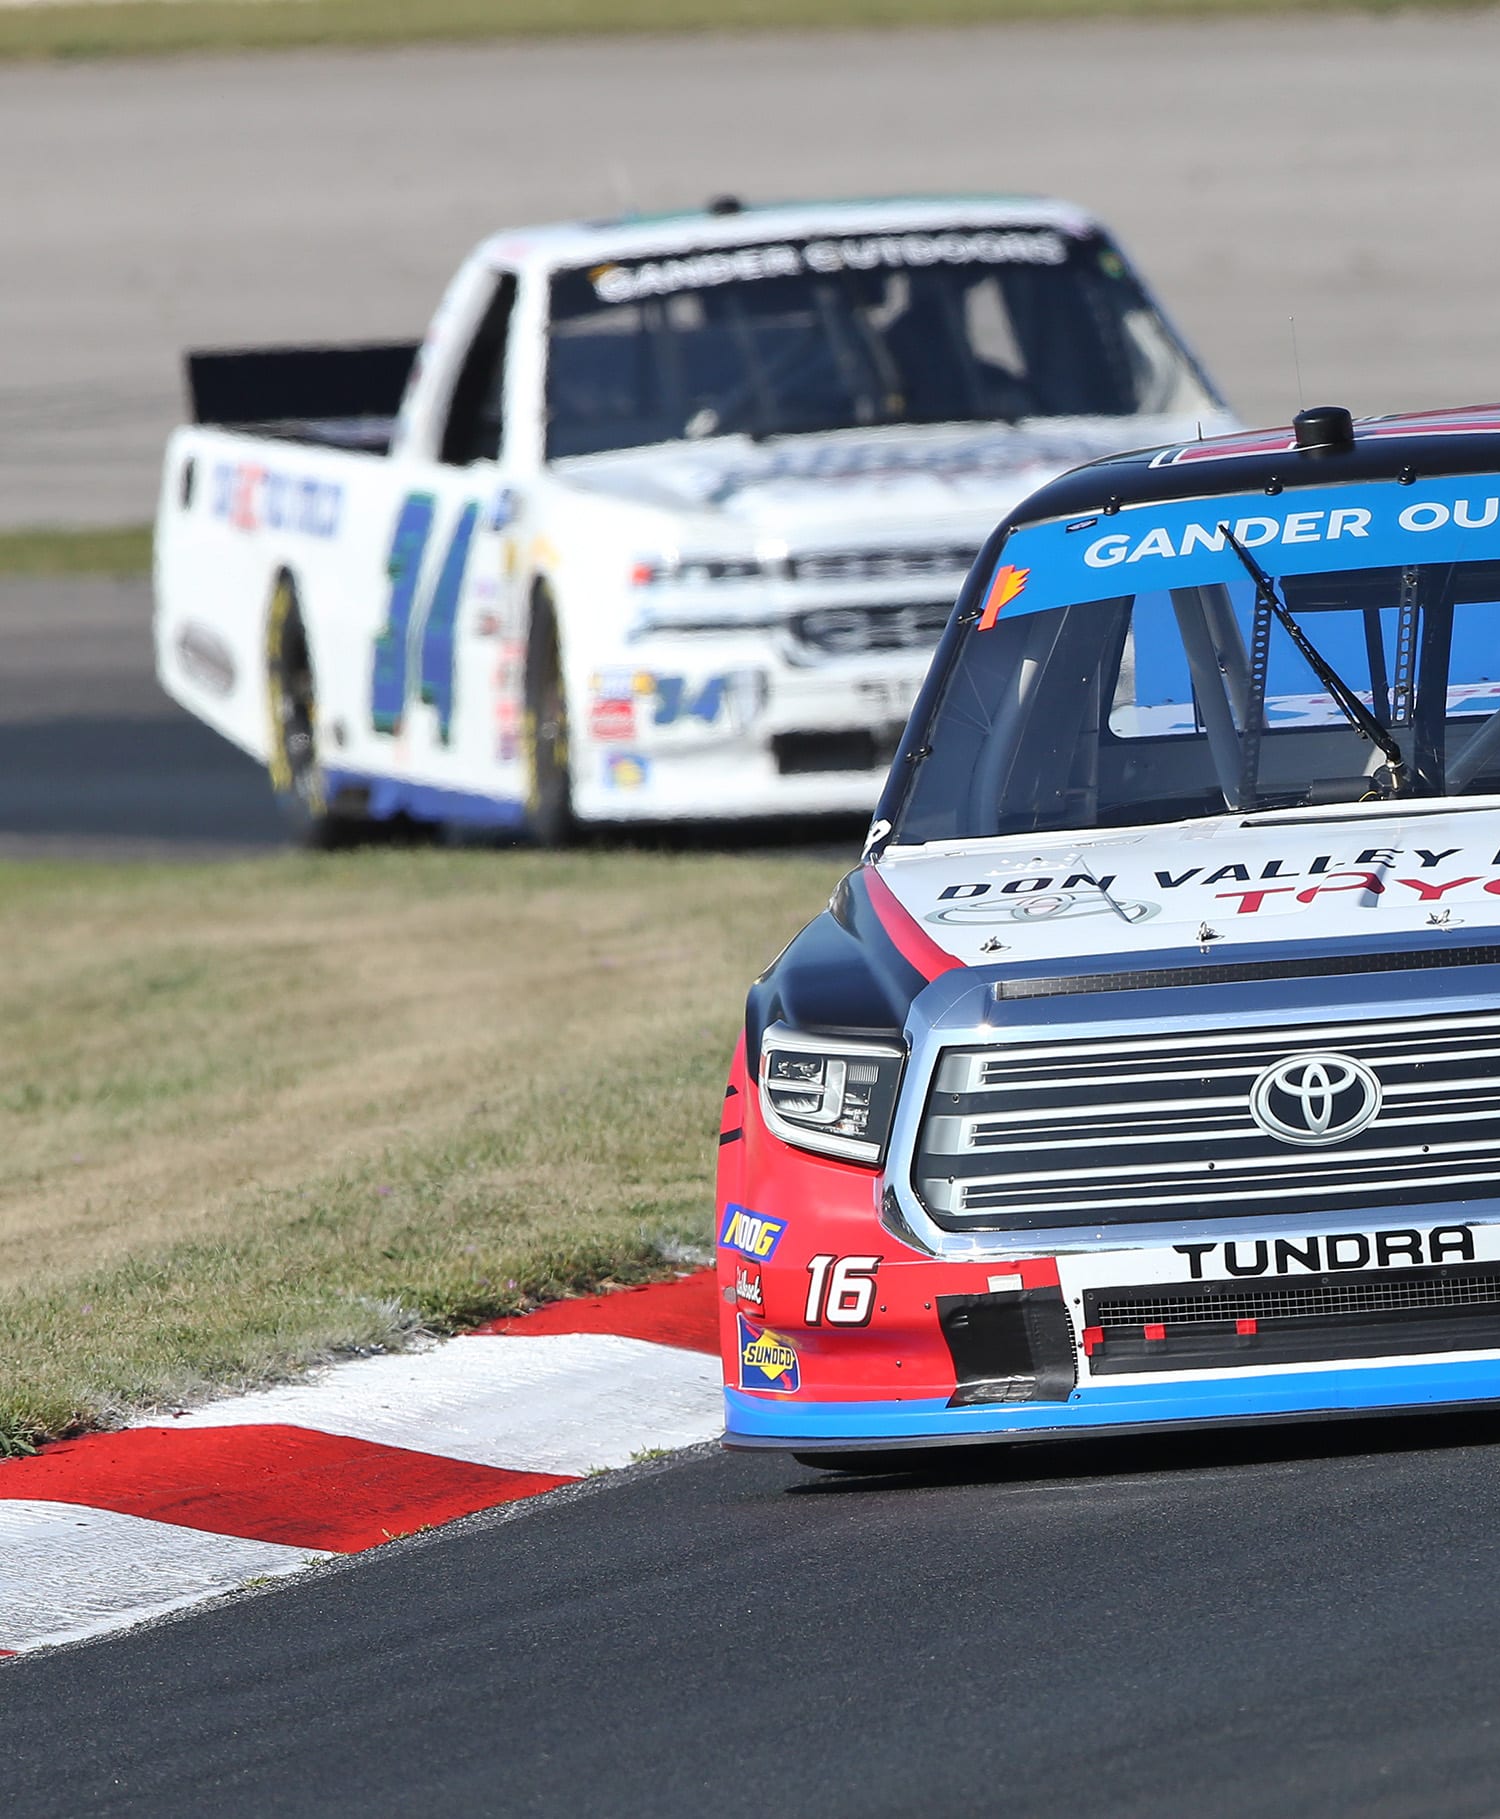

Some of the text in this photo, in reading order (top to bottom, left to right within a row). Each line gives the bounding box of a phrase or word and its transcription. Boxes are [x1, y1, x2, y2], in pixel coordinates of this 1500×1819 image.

[1084, 508, 1372, 568] GANDER
[938, 875, 1117, 899] DON
[1155, 848, 1463, 888] VALLEY
[723, 1211, 781, 1256] MOOG
[1172, 1225, 1475, 1279] TUNDRA
[804, 1254, 884, 1327] 16
[747, 1345, 792, 1367] SUNOCO
